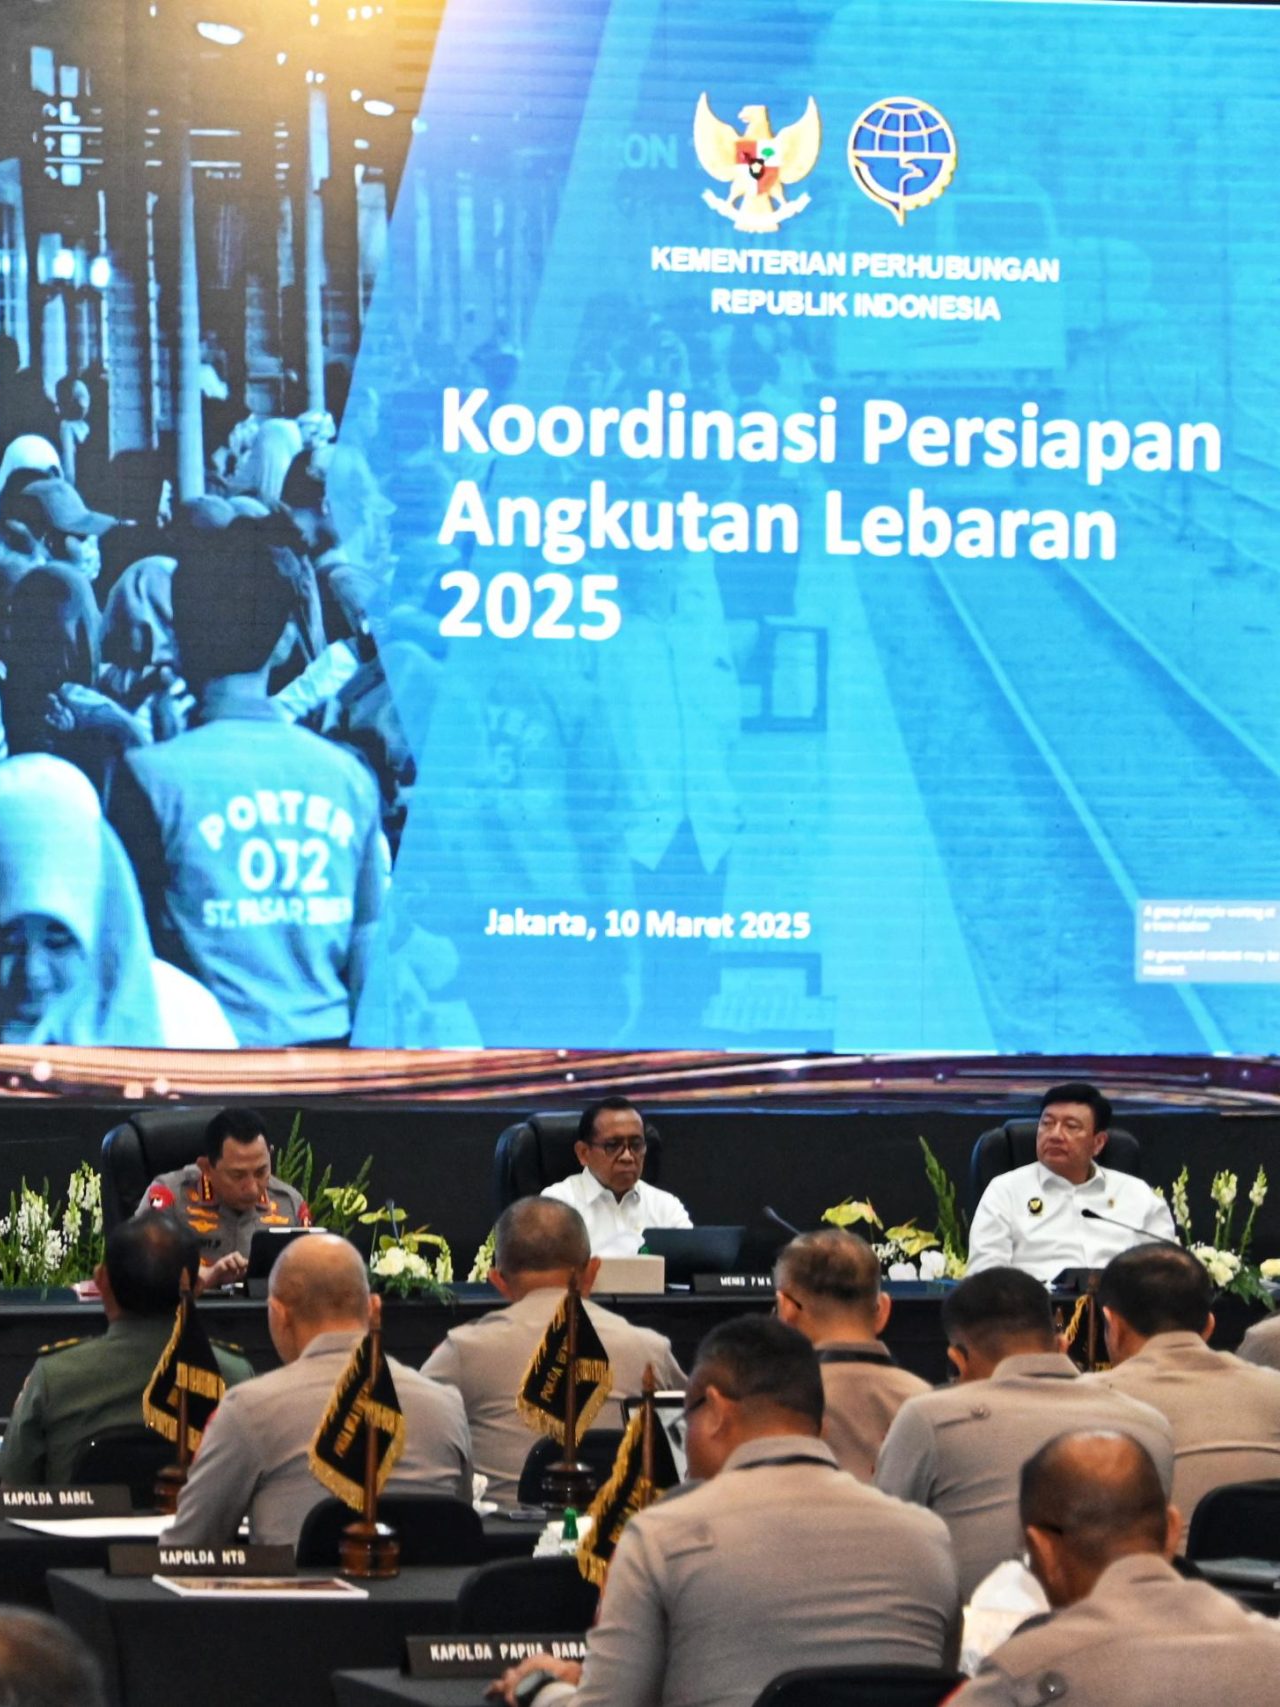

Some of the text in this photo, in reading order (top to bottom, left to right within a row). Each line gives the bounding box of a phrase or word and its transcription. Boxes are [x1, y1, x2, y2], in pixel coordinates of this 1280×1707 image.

[651, 246, 1060, 283] KEMENTERIAN PERHUBUNGAN
[711, 288, 1001, 320] REPUBLIK INDONESIA
[441, 387, 1222, 485] Koordinasi Persiapan
[438, 481, 1117, 564] Angkutan Lebaran
[439, 571, 622, 640] 2025
[198, 790, 355, 851] PORTER
[239, 837, 330, 893] 072
[485, 908, 811, 941] Jakarta, 10 Maret 2025
[2, 1490, 95, 1506] KAPOLDA BABEL
[159, 1550, 246, 1565] KAPOLDA NTB
[429, 1642, 493, 1661] KAPOLDA
[499, 1642, 544, 1660] PAPUA
